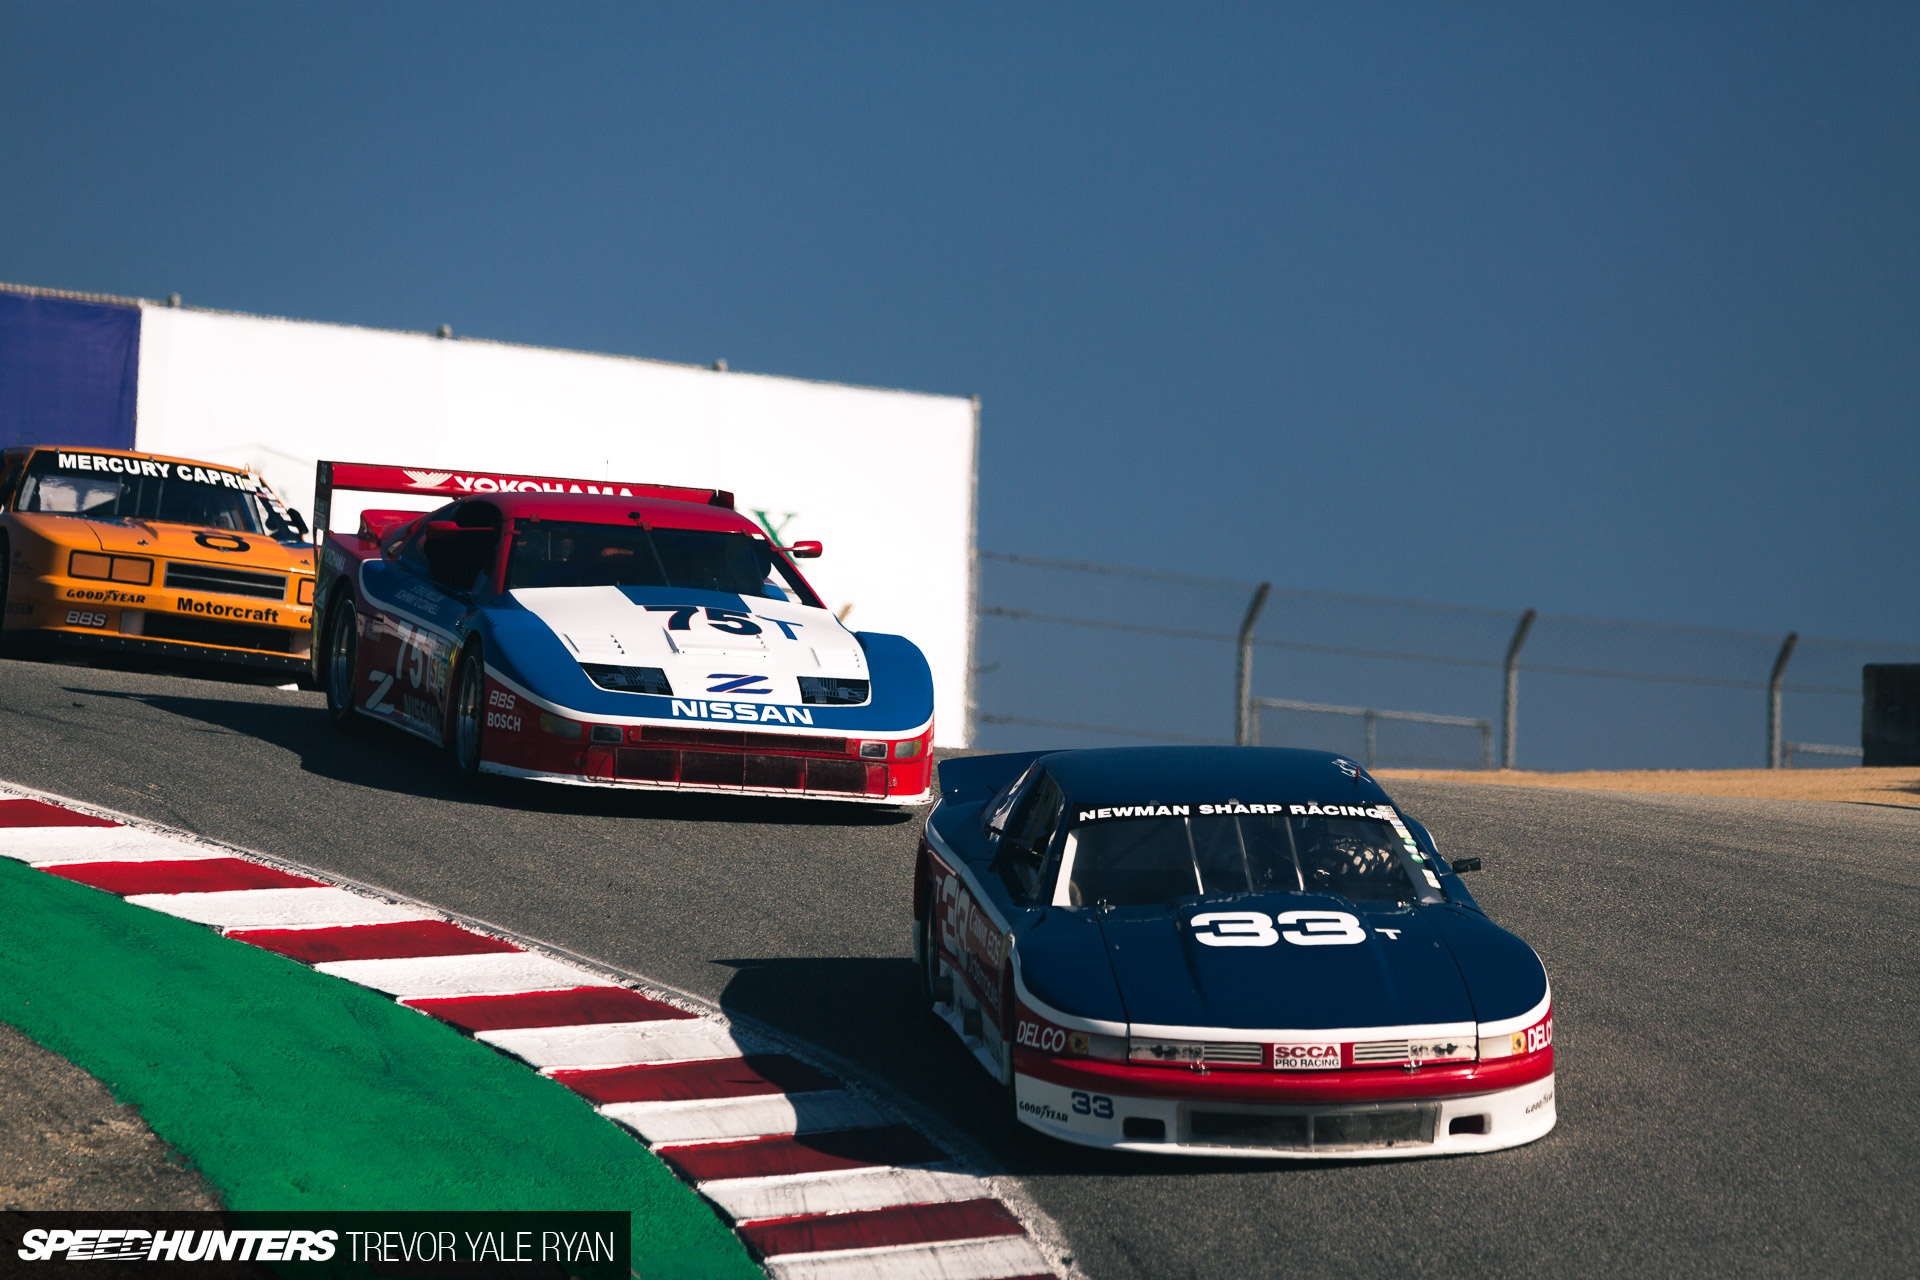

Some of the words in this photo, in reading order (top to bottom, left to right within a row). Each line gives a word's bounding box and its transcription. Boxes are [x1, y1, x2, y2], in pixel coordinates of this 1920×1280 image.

[58, 453, 171, 478] MERCURY
[176, 465, 245, 491] CAPRI
[66, 589, 146, 604] GOODYEAR
[65, 611, 108, 627] BBS
[177, 597, 279, 623] Motorcraft
[489, 690, 516, 710] BBS
[487, 712, 521, 732] BOSCH
[671, 700, 813, 725] NISSAN
[1079, 804, 1190, 822] NEWMAN
[1199, 804, 1283, 815] SHARP
[1290, 804, 1385, 820] RACING
[969, 904, 988, 948] Canon
[1190, 910, 1367, 947] 33
[1374, 927, 1402, 940] T
[986, 931, 1001, 967] EOS
[1016, 1020, 1067, 1053] DELCO
[1275, 1045, 1339, 1058] SCCA
[1275, 1058, 1297, 1068] PRO
[1301, 1058, 1339, 1068] RACING
[1019, 1100, 1068, 1123] GOODYEAR
[1071, 1091, 1114, 1119] 33
